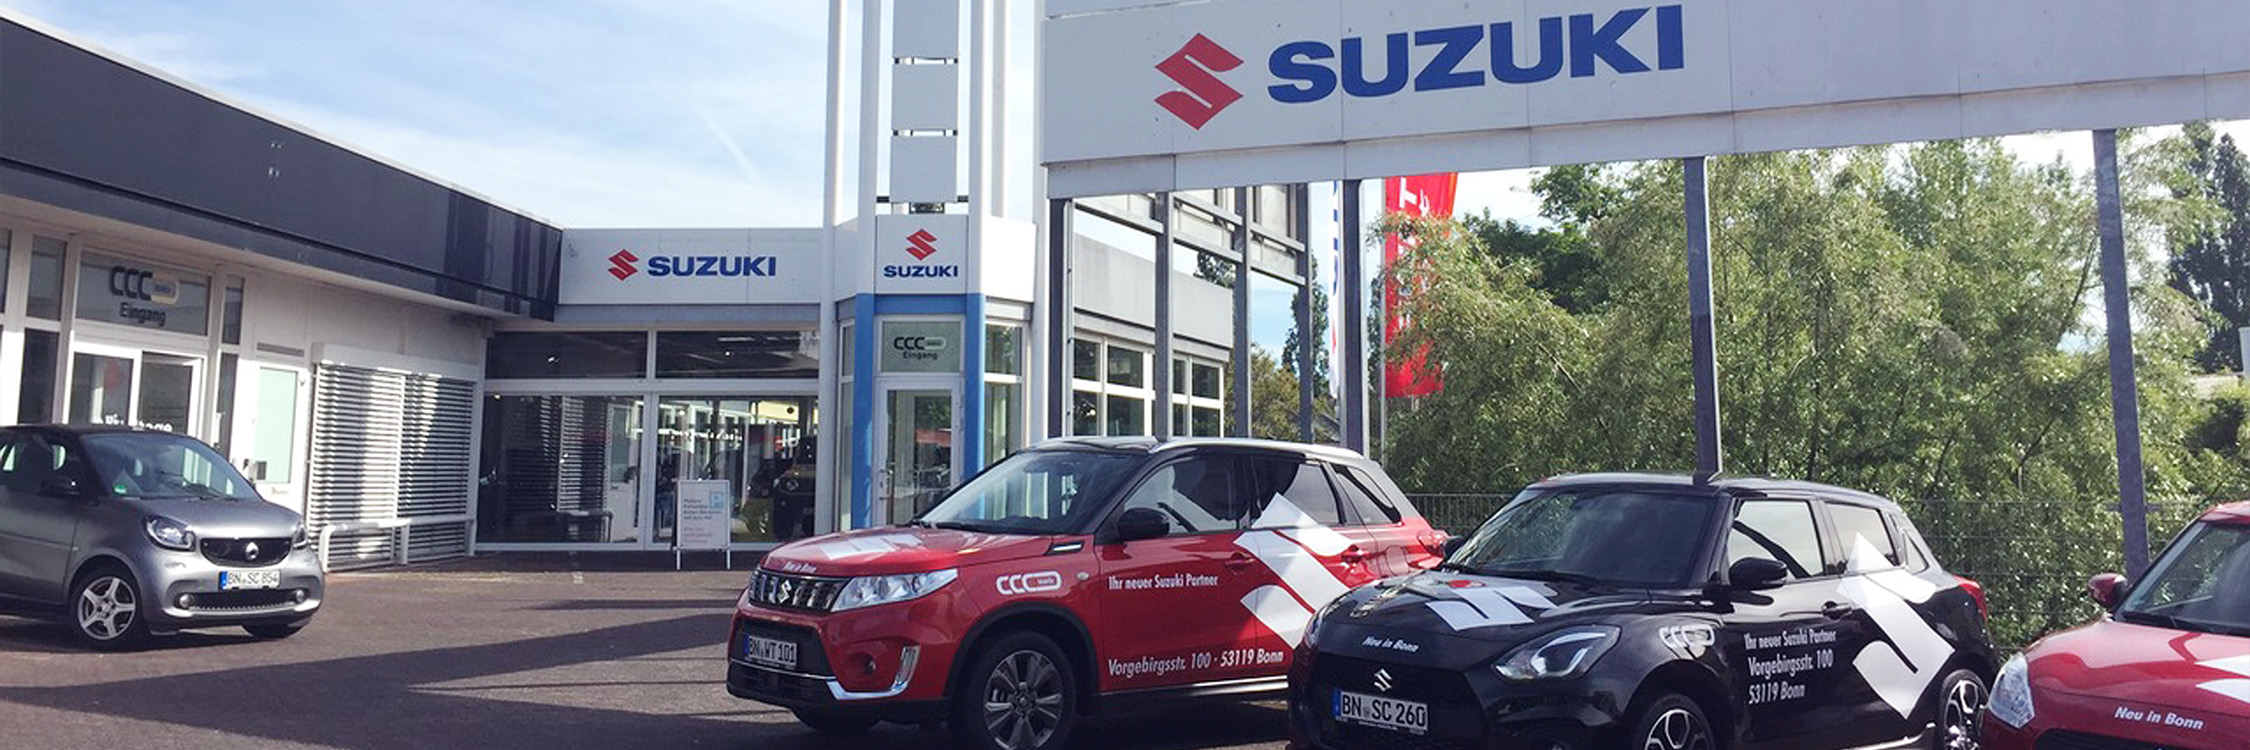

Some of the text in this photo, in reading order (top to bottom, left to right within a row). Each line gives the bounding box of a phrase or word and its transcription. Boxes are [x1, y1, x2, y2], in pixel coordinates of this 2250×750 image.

[1267, 4, 1685, 104] SUZUKI
[647, 256, 776, 277] SUZUKI
[883, 265, 958, 278] SUZUKI
[120, 302, 166, 327] Eingang
[903, 351, 938, 360] Eingang
[228, 572, 241, 584] BN
[1109, 573, 1218, 590] Ihr neuer Suzuki Partner
[1362, 635, 1420, 653] Neu in Bonn
[1744, 628, 1837, 650] Ihr neuer Suzuki Partner
[778, 643, 796, 663] 101
[1108, 648, 1284, 679] Vorgebirgsstr. 100 53119 Bonn
[1748, 649, 1834, 679] Vorgebirgsstr. 100
[1748, 681, 1805, 704] 53119 Bonn
[1342, 694, 1362, 717] BN
[1372, 699, 1392, 721] SC
[1395, 703, 1426, 727] 260
[2114, 706, 2204, 730] Neu in Bonn
